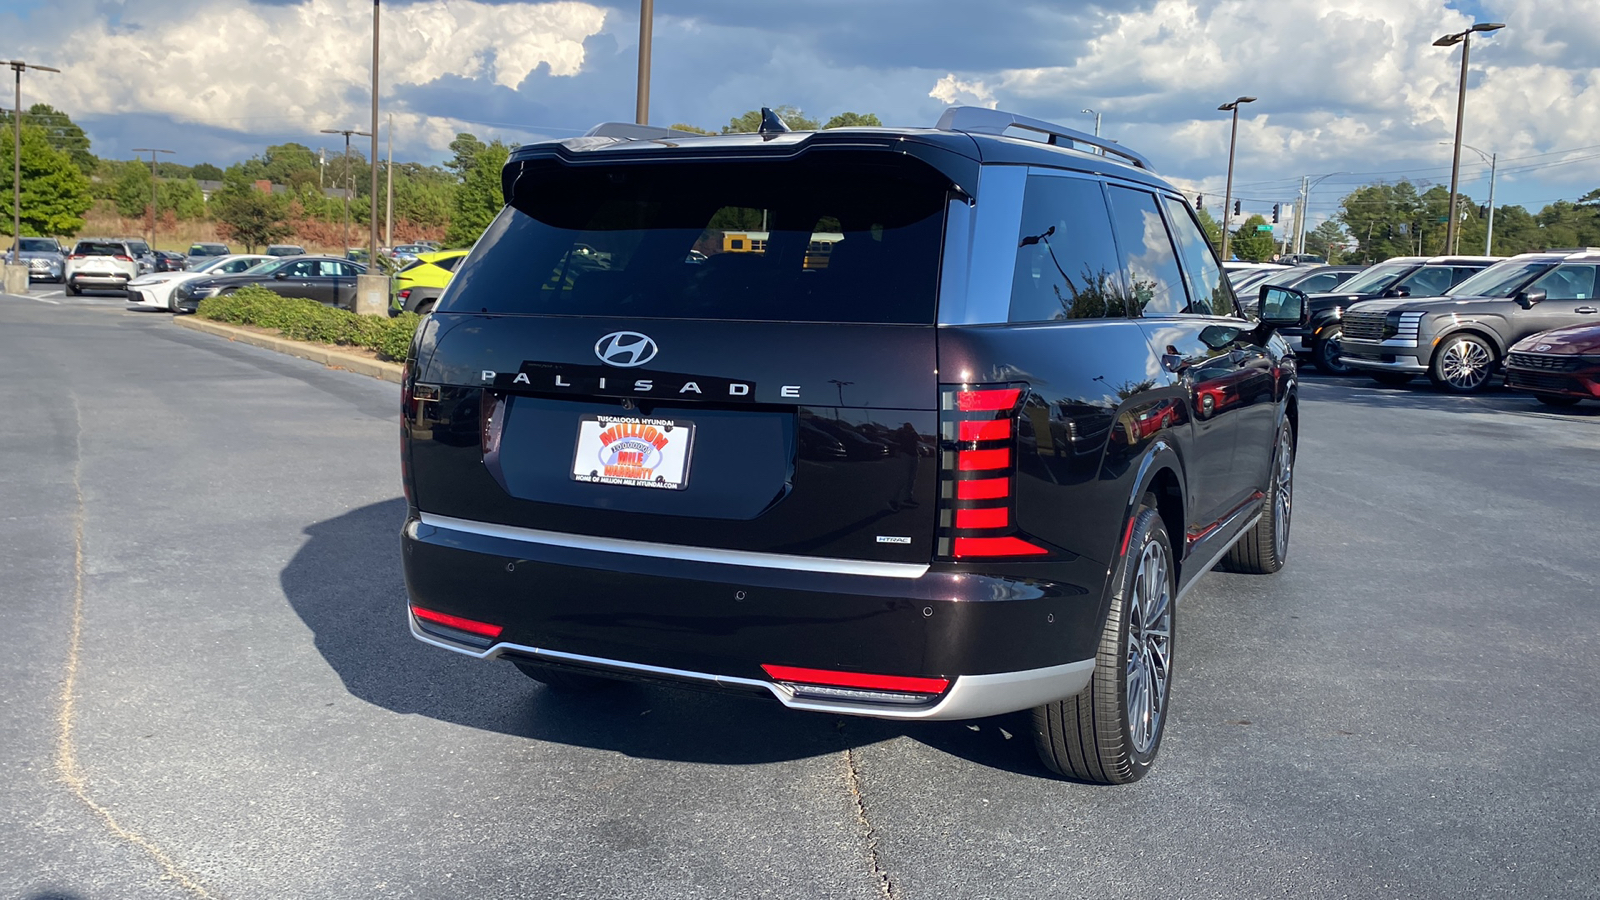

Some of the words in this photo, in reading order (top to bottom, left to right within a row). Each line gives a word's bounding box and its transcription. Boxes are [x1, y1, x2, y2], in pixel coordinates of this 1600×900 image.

[481, 370, 801, 399] PALISADE
[597, 416, 640, 424] TUSCALOOSA
[642, 418, 674, 426] HYUNDAI
[599, 423, 669, 451] MILLION
[617, 451, 644, 467] MILE
[604, 465, 654, 480] WARRANTY
[600, 477, 623, 485] MILLION
